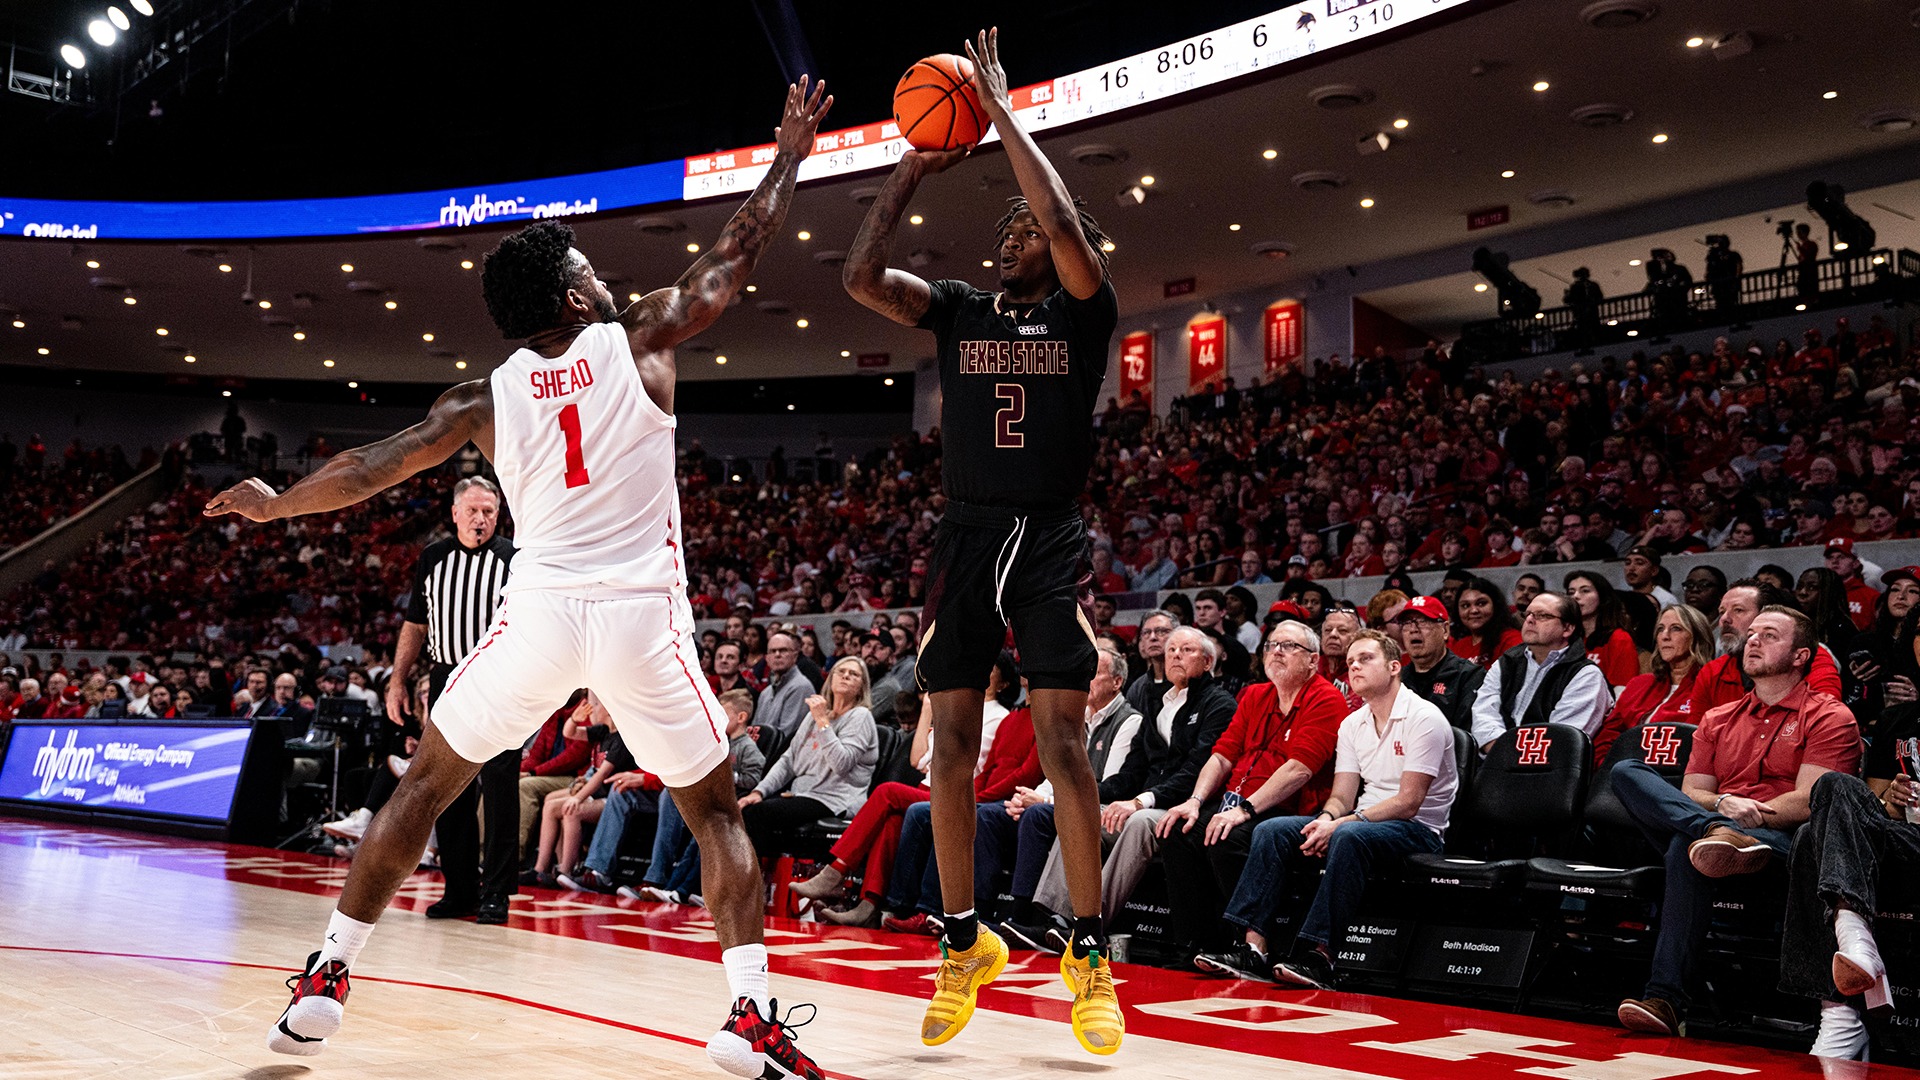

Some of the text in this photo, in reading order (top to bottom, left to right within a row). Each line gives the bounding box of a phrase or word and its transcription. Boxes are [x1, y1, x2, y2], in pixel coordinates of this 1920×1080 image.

[1252, 24, 1268, 47] 6
[1157, 37, 1214, 73] 8:06
[1100, 66, 1129, 92] 16
[1037, 107, 1047, 120] 4
[884, 141, 901, 157] 10
[959, 340, 1069, 375] TEXAS STATE
[1198, 343, 1216, 366] 44
[530, 358, 594, 399] SHEAD
[995, 383, 1025, 448] 2
[557, 403, 590, 489] 1
[103, 742, 195, 769] Official Energy Company
[1515, 727, 1552, 765] UH
[1640, 726, 1682, 765] UH
[1560, 885, 1595, 894] FL4:1:20
[1713, 901, 1744, 910] L4:1:21
[1876, 911, 1914, 920] L4:1:22
[1346, 935, 1372, 944] otham
[1367, 926, 1397, 936] Edward
[1338, 951, 1366, 961] L4:1:18
[1443, 940, 1500, 952] Beth Madison
[1447, 965, 1482, 975] FL4:1:19
